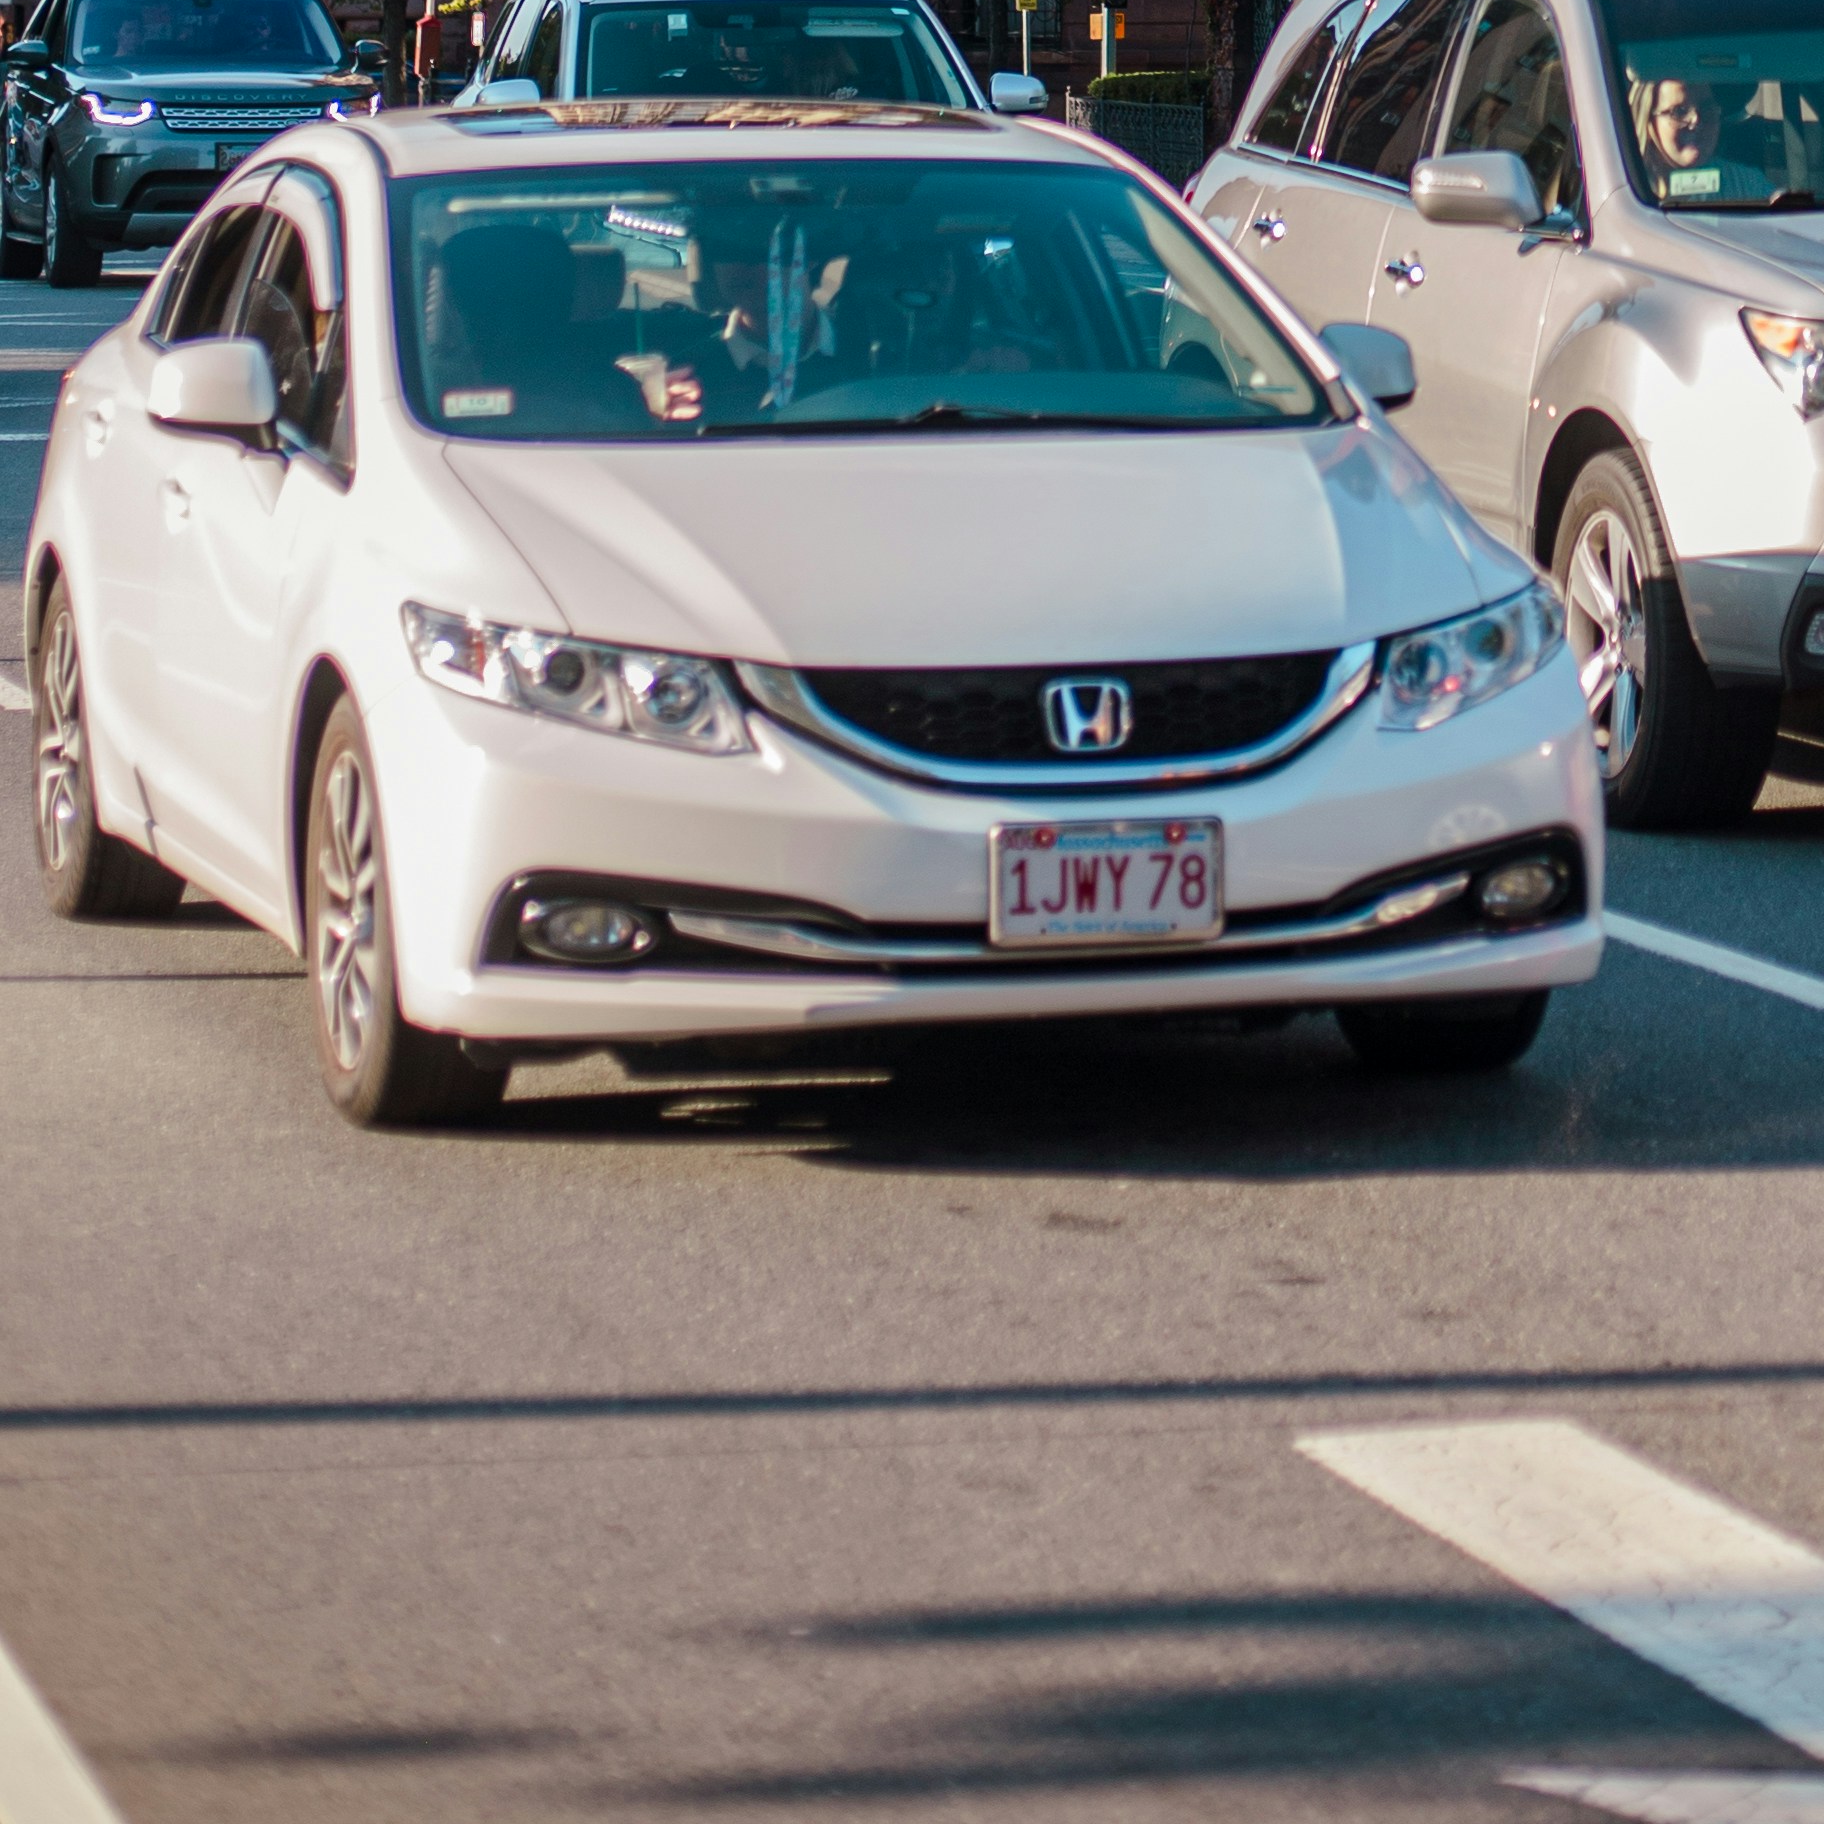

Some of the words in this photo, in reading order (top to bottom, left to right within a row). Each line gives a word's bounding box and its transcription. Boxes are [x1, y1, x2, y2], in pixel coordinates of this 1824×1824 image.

[175, 93, 307, 101] DISCOVERY
[1009, 854, 1131, 916] 1JWY
[1149, 853, 1207, 911] 78
